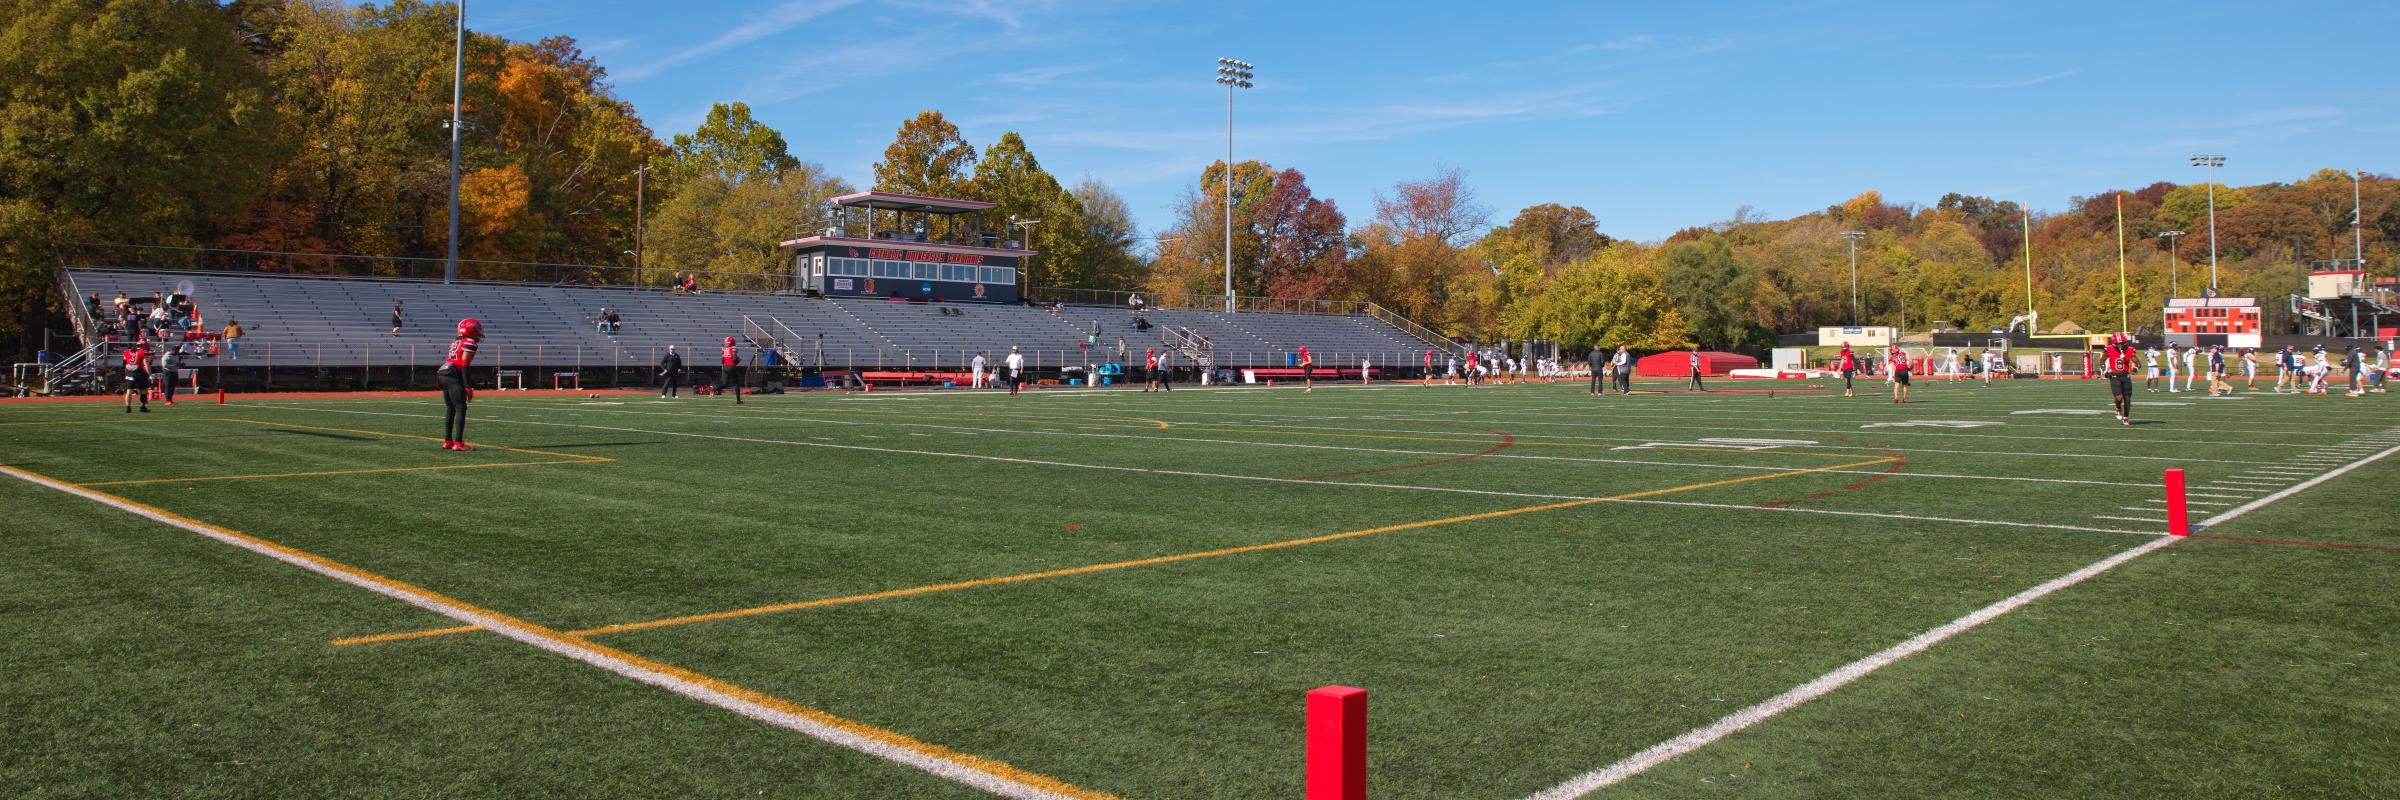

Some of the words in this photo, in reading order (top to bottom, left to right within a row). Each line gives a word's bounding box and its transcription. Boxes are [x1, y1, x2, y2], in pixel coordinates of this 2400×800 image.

[869, 249, 903, 260] CATHOLIC
[906, 250, 945, 262] UNIVERSITY
[947, 254, 984, 265] CARDINALS
[2169, 298, 2207, 306] CATHOLIC
[2208, 298, 2255, 306] UNIVERSITY
